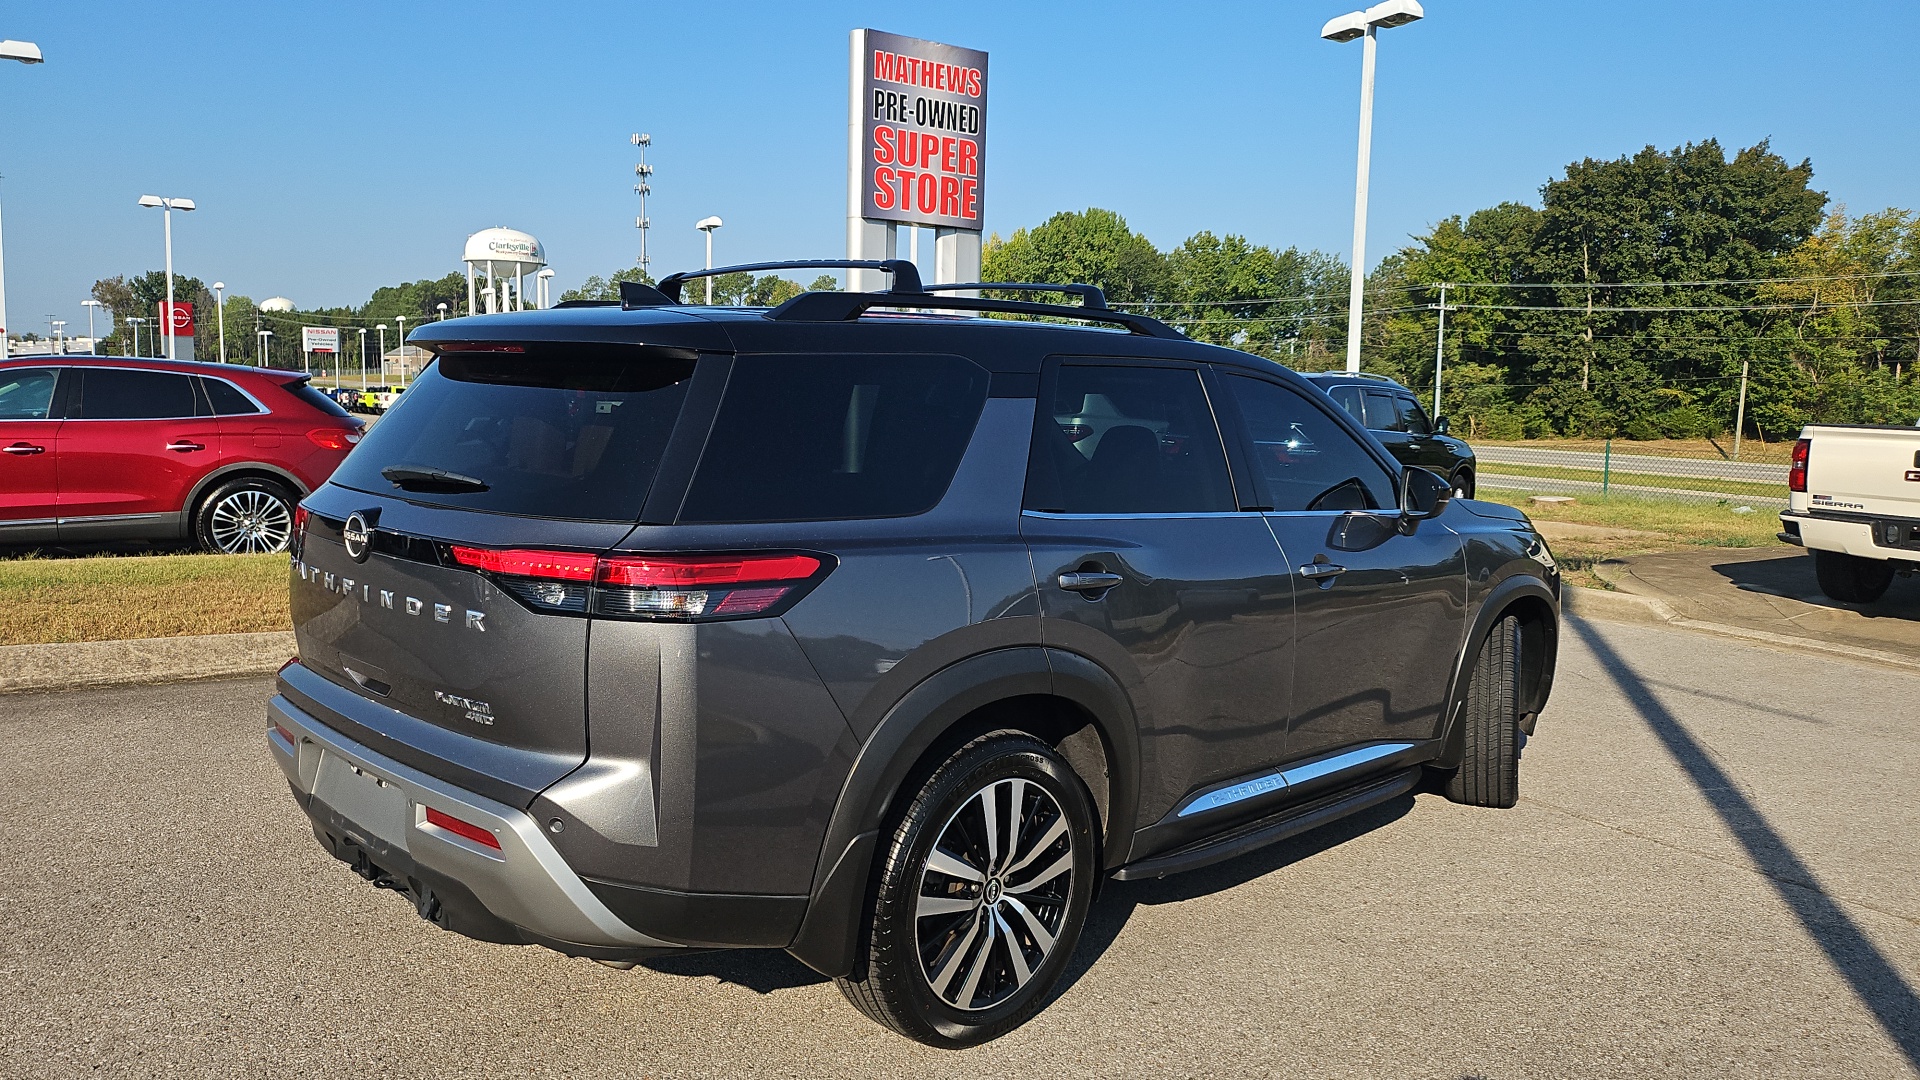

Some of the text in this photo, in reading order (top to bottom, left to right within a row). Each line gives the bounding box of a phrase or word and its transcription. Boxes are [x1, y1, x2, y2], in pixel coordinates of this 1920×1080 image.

[874, 50, 982, 98] MATHEWS
[873, 87, 979, 135] PRE-OWNED
[873, 125, 978, 177] SUPER
[874, 166, 978, 220] STORE
[489, 242, 529, 251] Clarksville
[1812, 500, 1864, 509] SIERRA
[1021, 754, 1044, 764] CROSS
